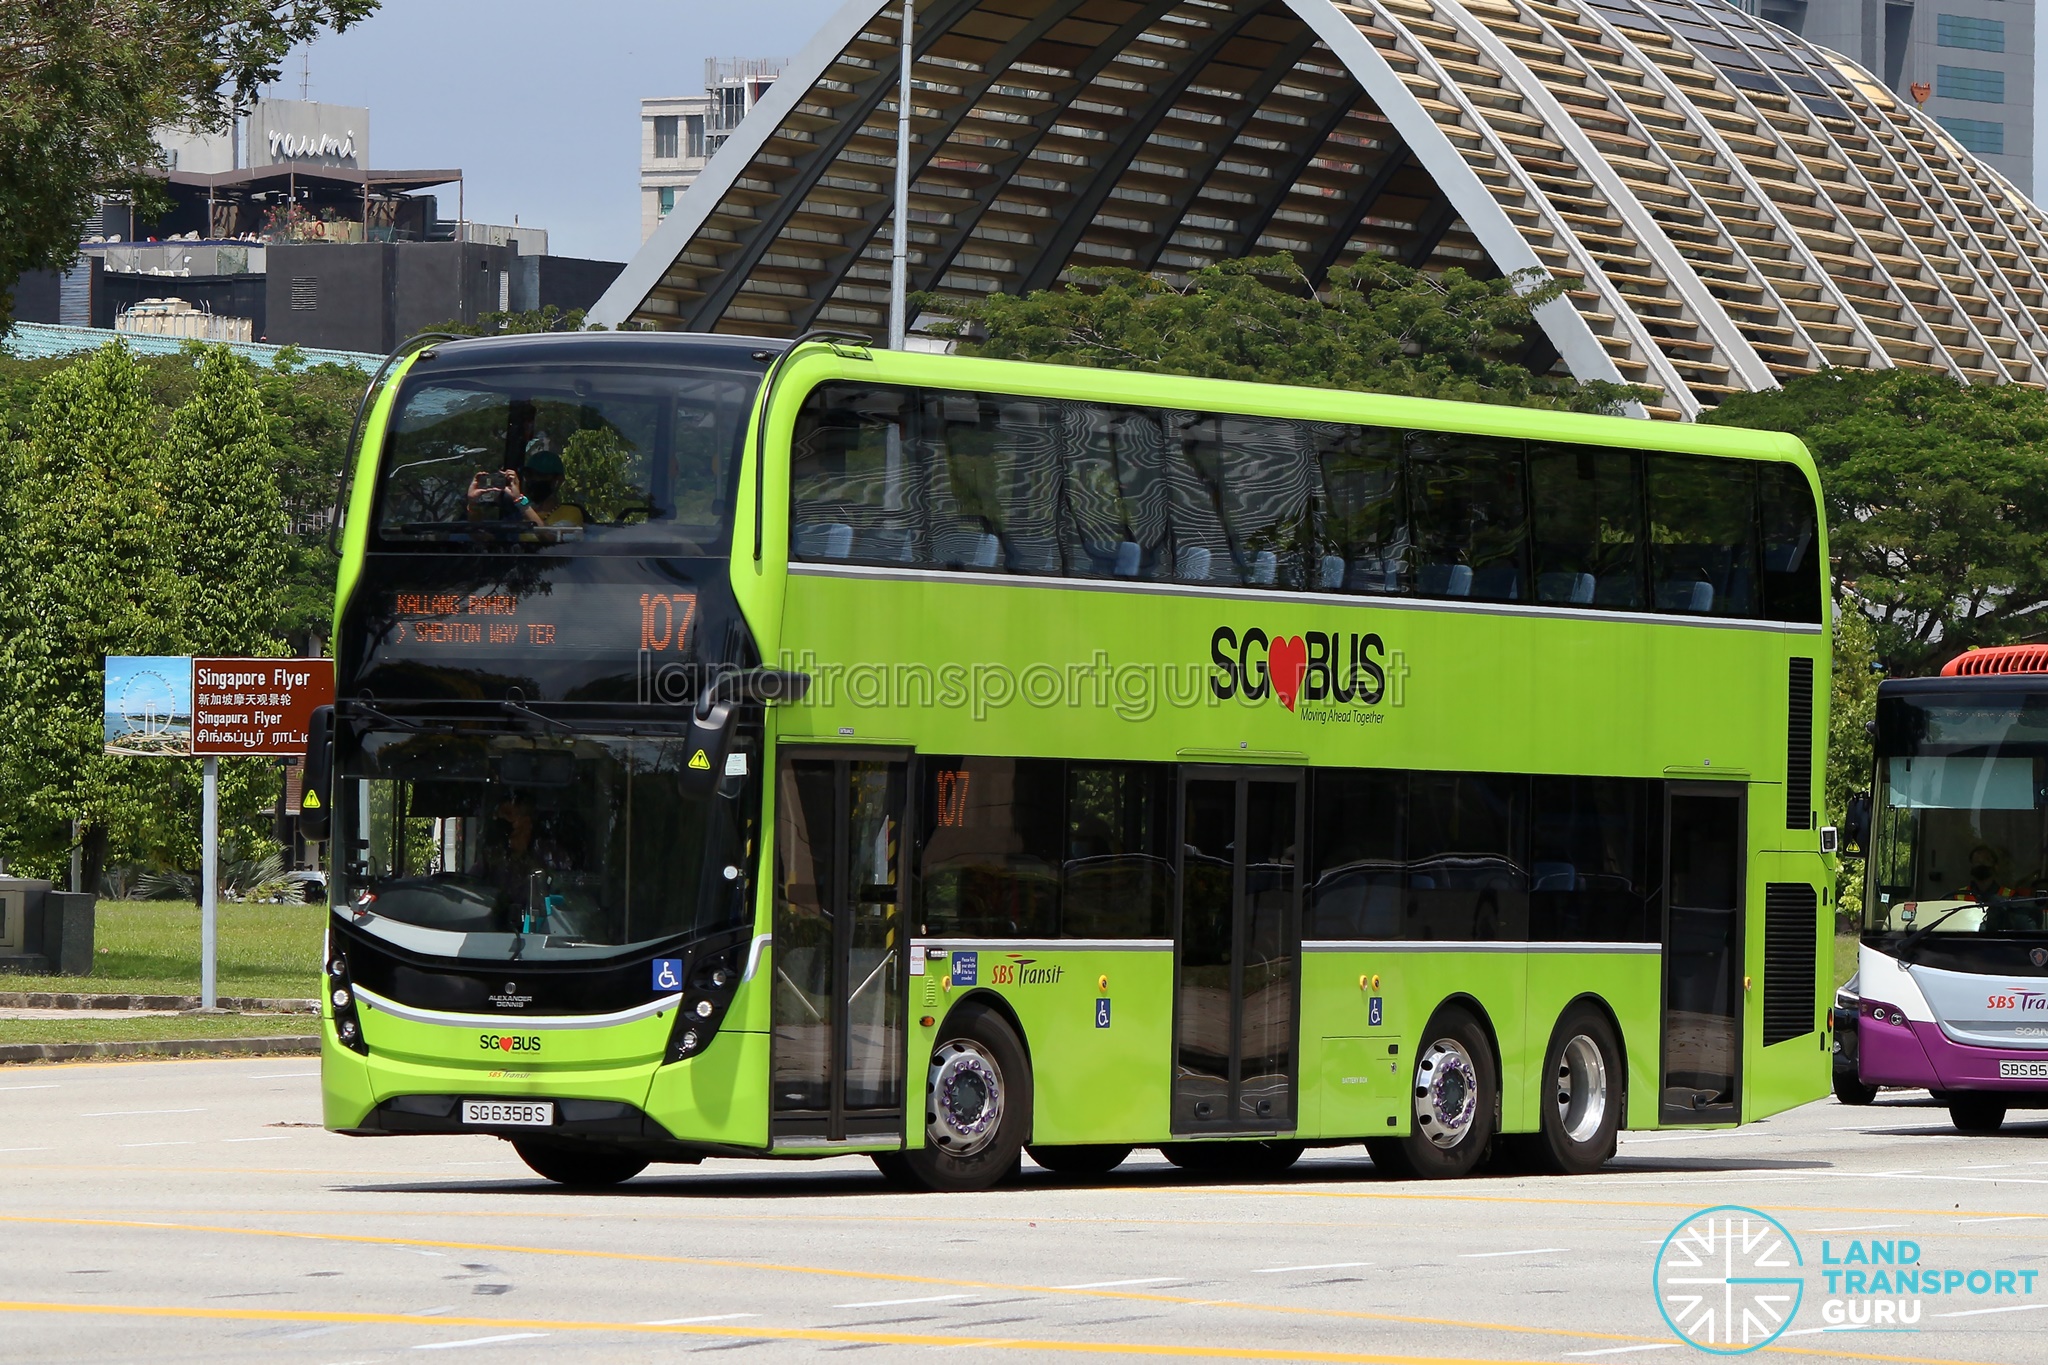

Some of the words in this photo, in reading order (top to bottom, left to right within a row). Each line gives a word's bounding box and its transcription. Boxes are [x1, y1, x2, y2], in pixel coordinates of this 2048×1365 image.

[396, 594, 460, 615] KALLANG
[468, 595, 517, 615] BAHRU
[639, 593, 697, 650] 107
[415, 622, 481, 643] SHENTON
[489, 624, 519, 644] WAY
[527, 624, 556, 644] TER
[198, 668, 266, 690] Singapore
[274, 668, 311, 690] Flyer
[198, 693, 292, 706] 新加坡摩天观景轮
[197, 711, 249, 727] Singapura
[254, 711, 282, 728] Flyer
[1301, 707, 1326, 725] Moving
[1328, 709, 1351, 722] Ahead
[1353, 709, 1384, 726] Together
[197, 729, 265, 748] சிங்கப்பூர்
[937, 770, 970, 827] 107
[991, 965, 1014, 985] SBS
[1013, 959, 1065, 988] Transit
[1987, 995, 2015, 1009] SBS
[2014, 992, 2048, 1012] Tra
[502, 1070, 530, 1079] Transit
[470, 1105, 545, 1122] SG6358S
